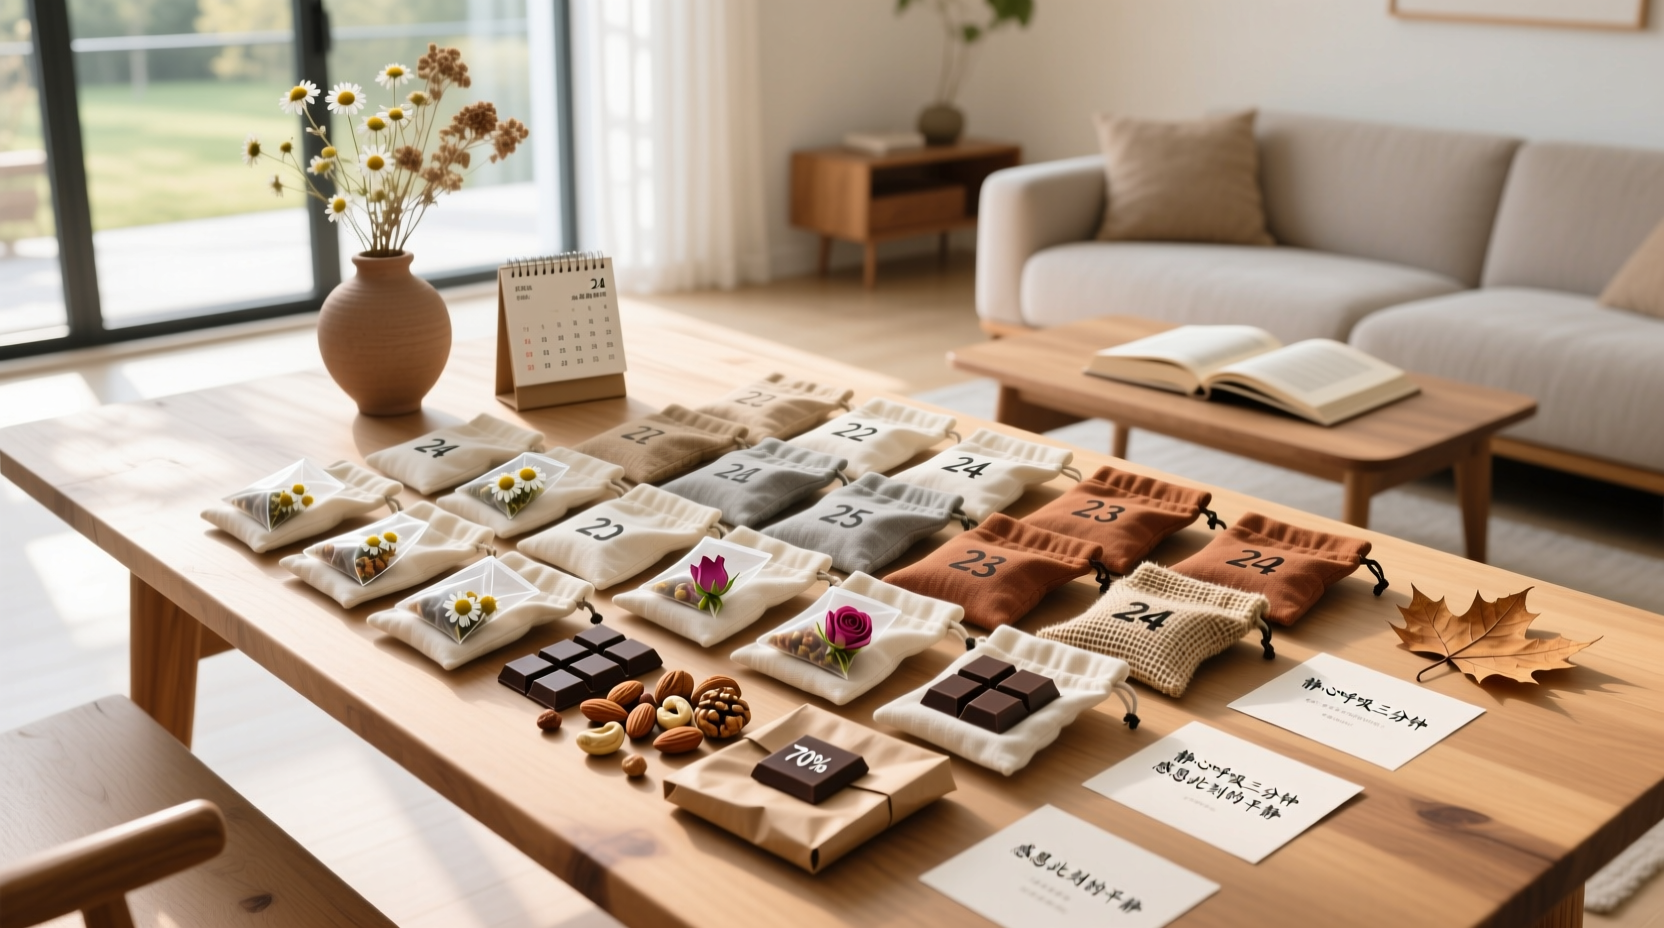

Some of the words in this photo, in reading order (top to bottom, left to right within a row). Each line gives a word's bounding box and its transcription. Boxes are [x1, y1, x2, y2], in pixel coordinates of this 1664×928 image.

[831, 423, 878, 442] 22
[414, 438, 460, 458] 24
[941, 456, 992, 479] 24
[819, 504, 874, 529] 25
[1072, 500, 1126, 523] 23
[948, 550, 1007, 578] 23
[1225, 549, 1285, 576] 24
[1111, 602, 1175, 631] 24
[785, 744, 831, 773] 70%
